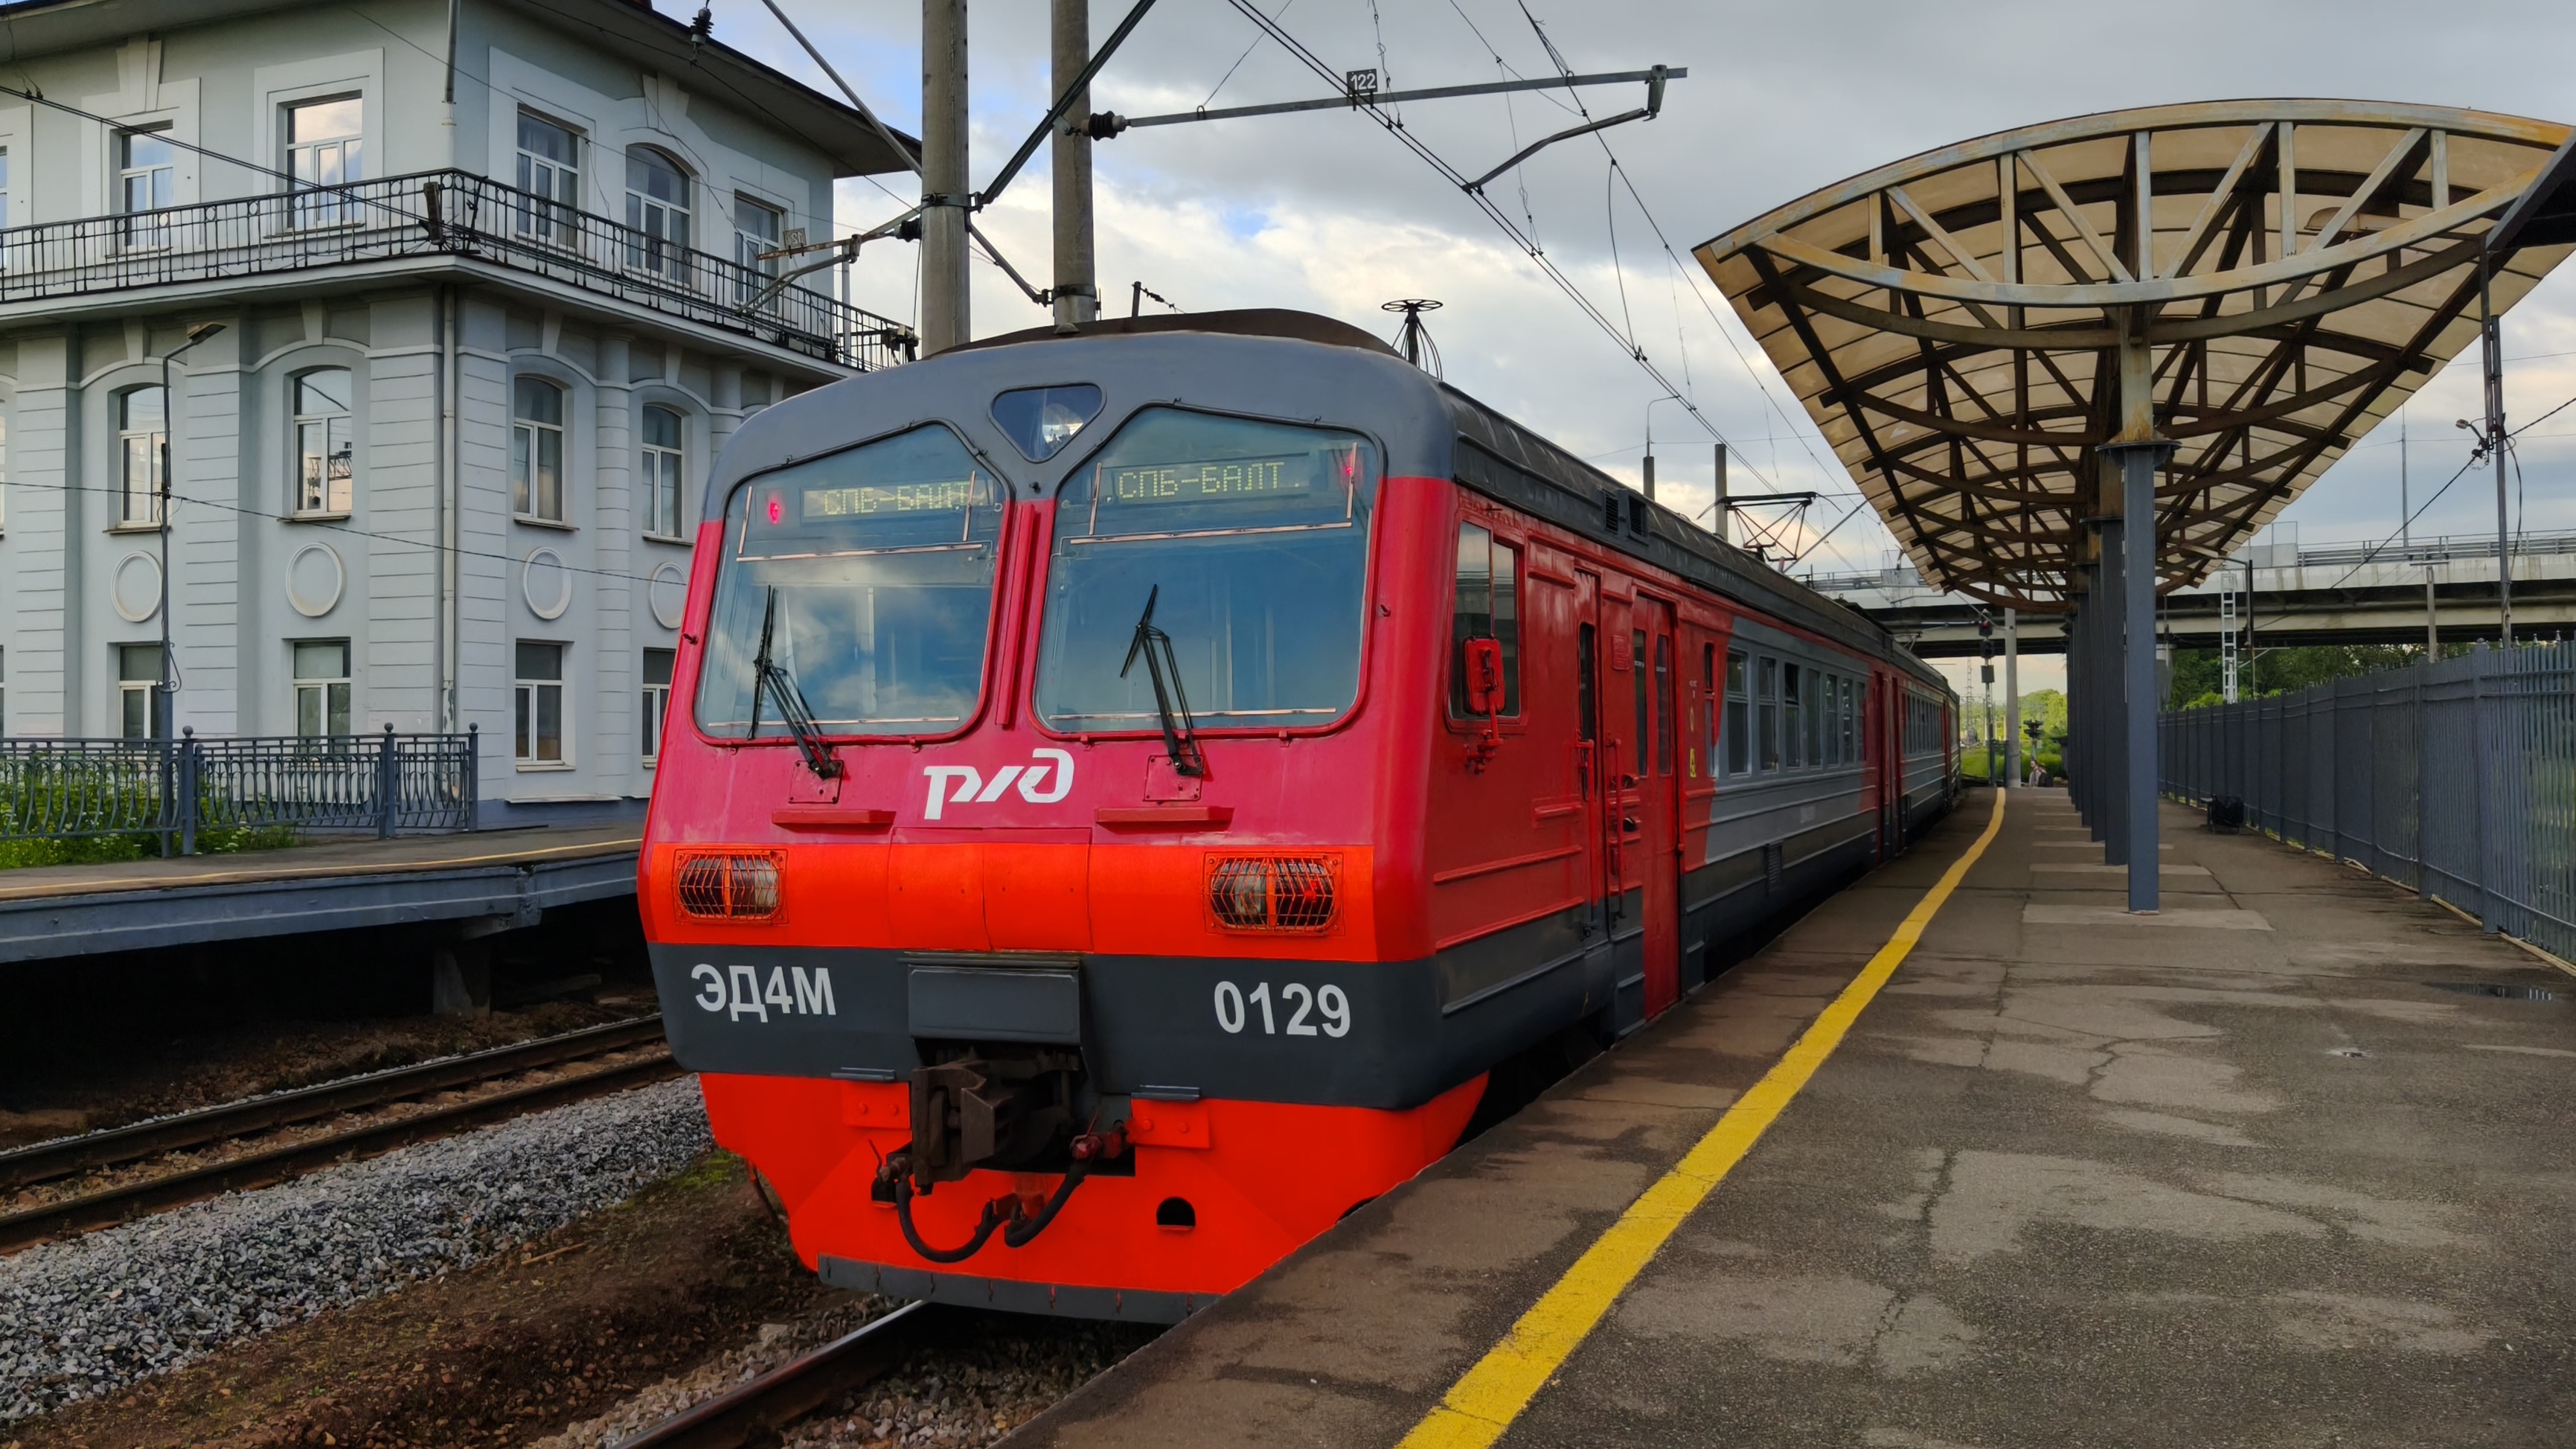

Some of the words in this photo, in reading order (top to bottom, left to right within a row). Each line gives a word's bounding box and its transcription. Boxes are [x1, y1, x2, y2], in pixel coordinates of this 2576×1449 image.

[1351, 73, 1377, 91] 122
[691, 963, 836, 1023] ЭД4М
[1214, 981, 1351, 1037] 0129
